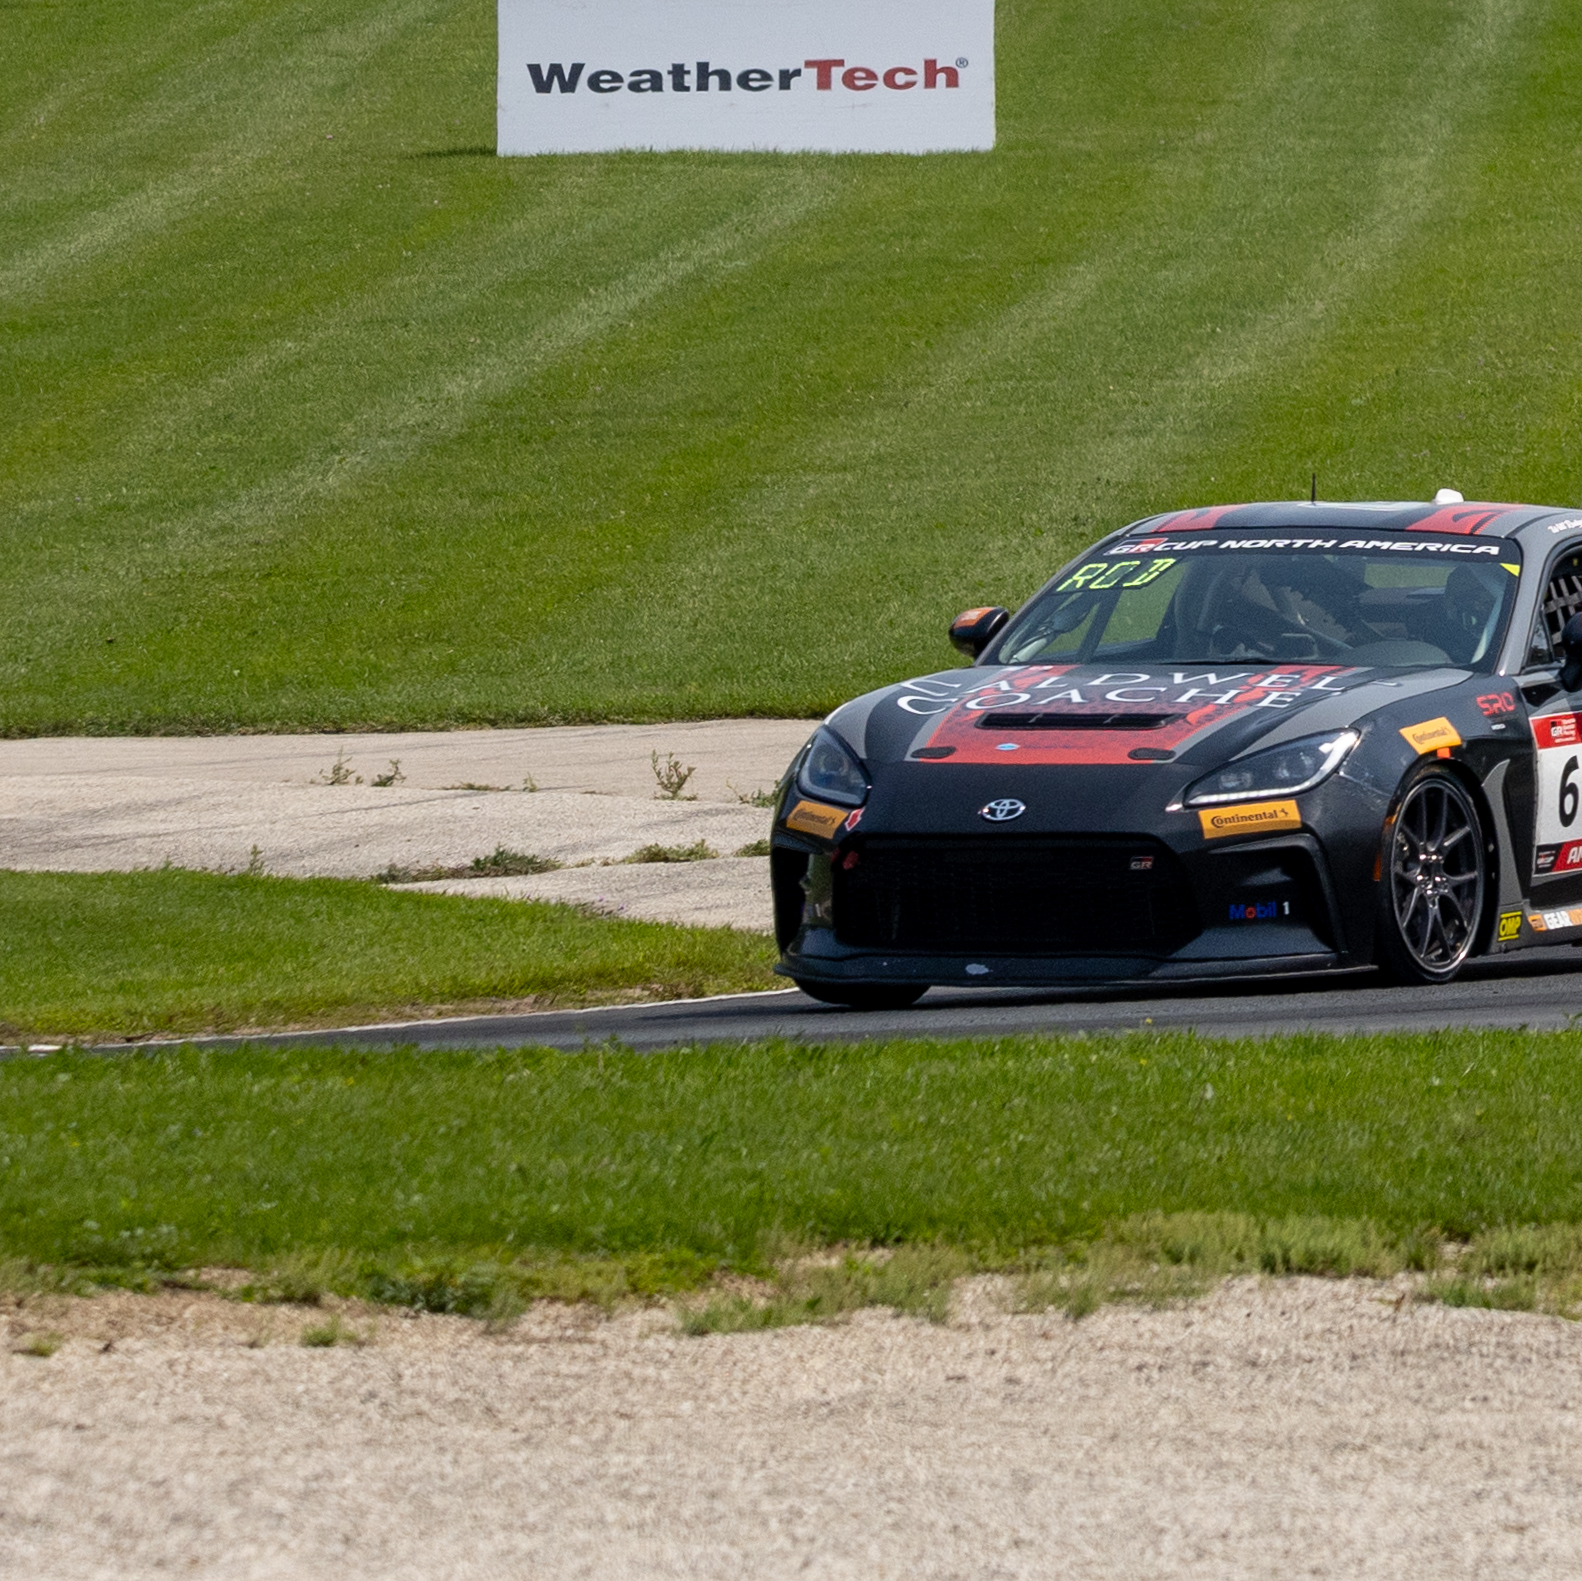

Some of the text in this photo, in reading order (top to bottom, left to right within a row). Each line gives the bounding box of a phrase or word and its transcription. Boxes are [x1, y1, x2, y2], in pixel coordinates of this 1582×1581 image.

[525, 57, 961, 94] WeatherTech
[1152, 539, 1220, 552] CUP
[1218, 537, 1338, 551] NORTH
[1339, 539, 1501, 556] AMERICA
[1475, 691, 1517, 717] SRO
[1558, 754, 1580, 828] 6
[1210, 809, 1278, 829] Continental
[1228, 901, 1291, 919] Mobil 1
